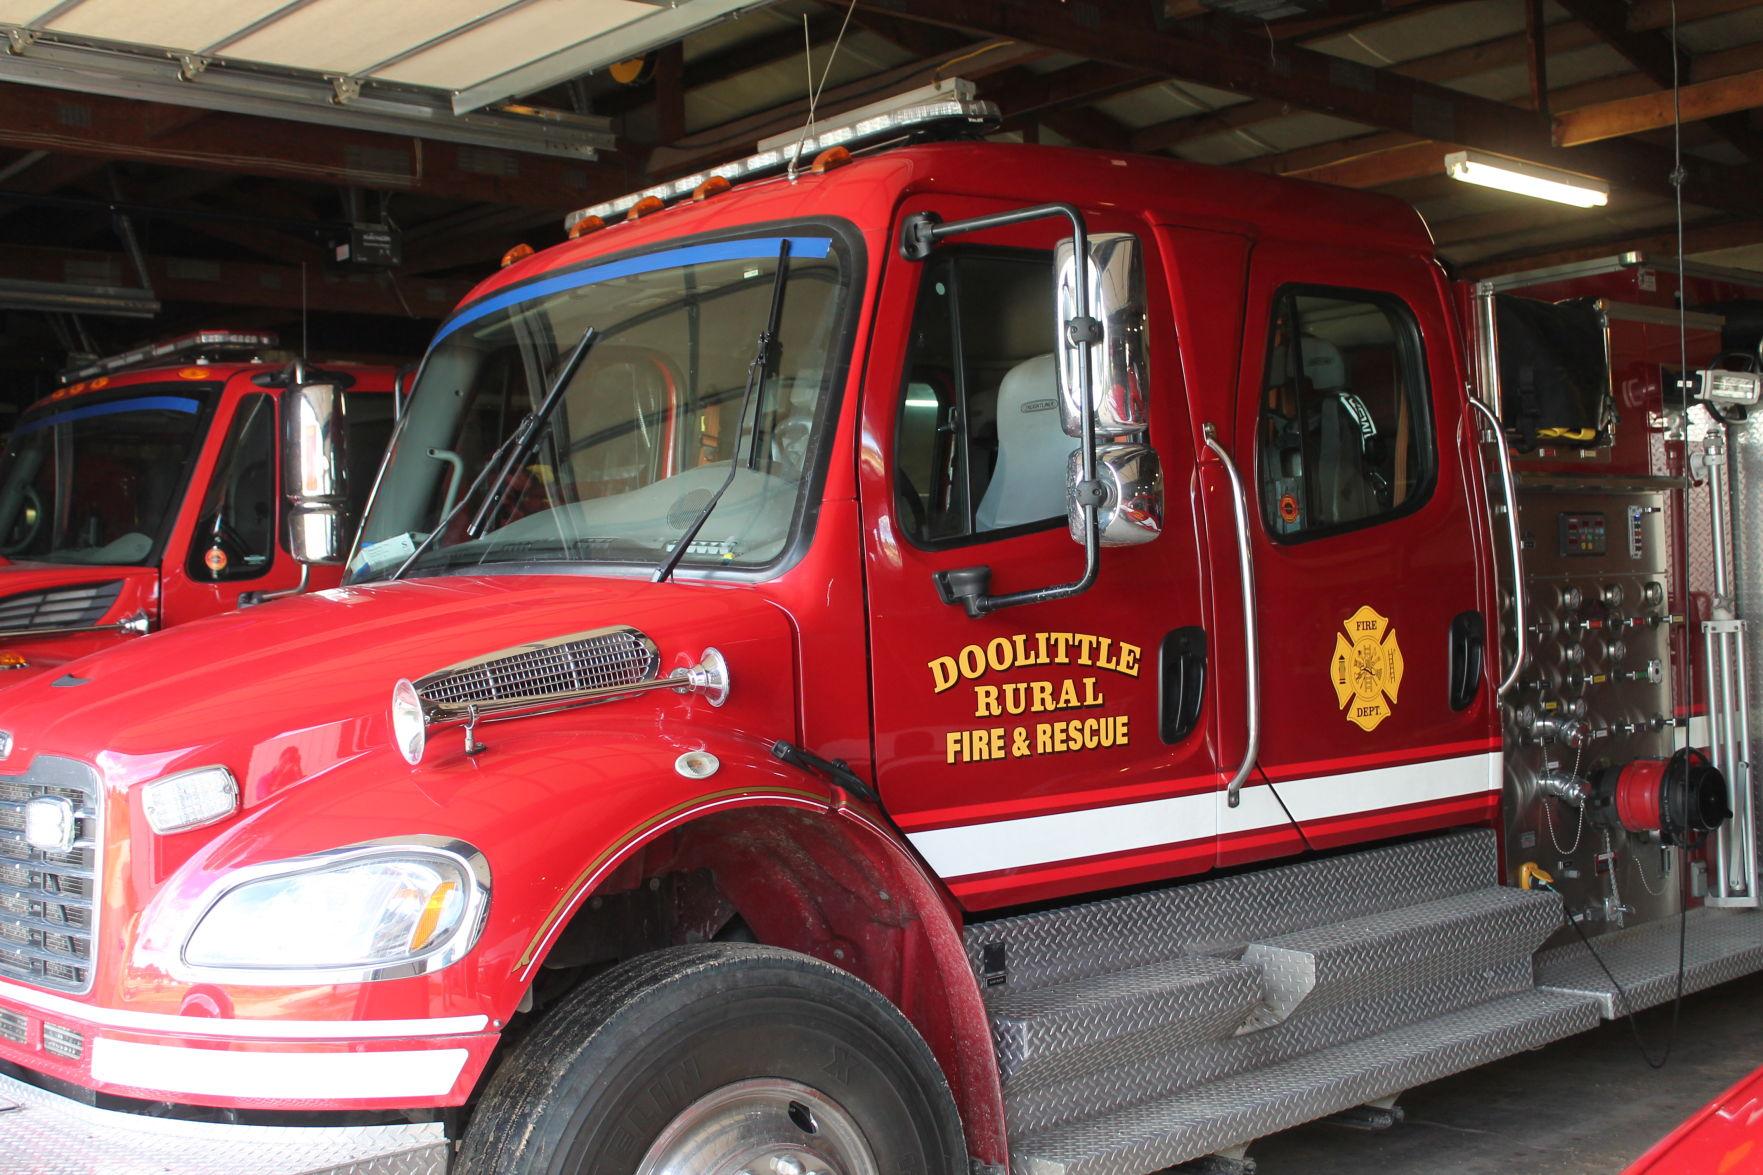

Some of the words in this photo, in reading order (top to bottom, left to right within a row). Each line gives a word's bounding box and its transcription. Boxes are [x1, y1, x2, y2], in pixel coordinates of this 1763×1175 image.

[1356, 620, 1377, 631] FIRE
[927, 632, 1141, 693] DOOLITTLE
[974, 677, 1103, 717] RURAL
[1357, 706, 1382, 717] DEPT.
[946, 727, 1006, 764] FIRE
[1011, 726, 1031, 757] &
[1036, 715, 1129, 754] RESCUE
[594, 1055, 704, 1168] ELIN
